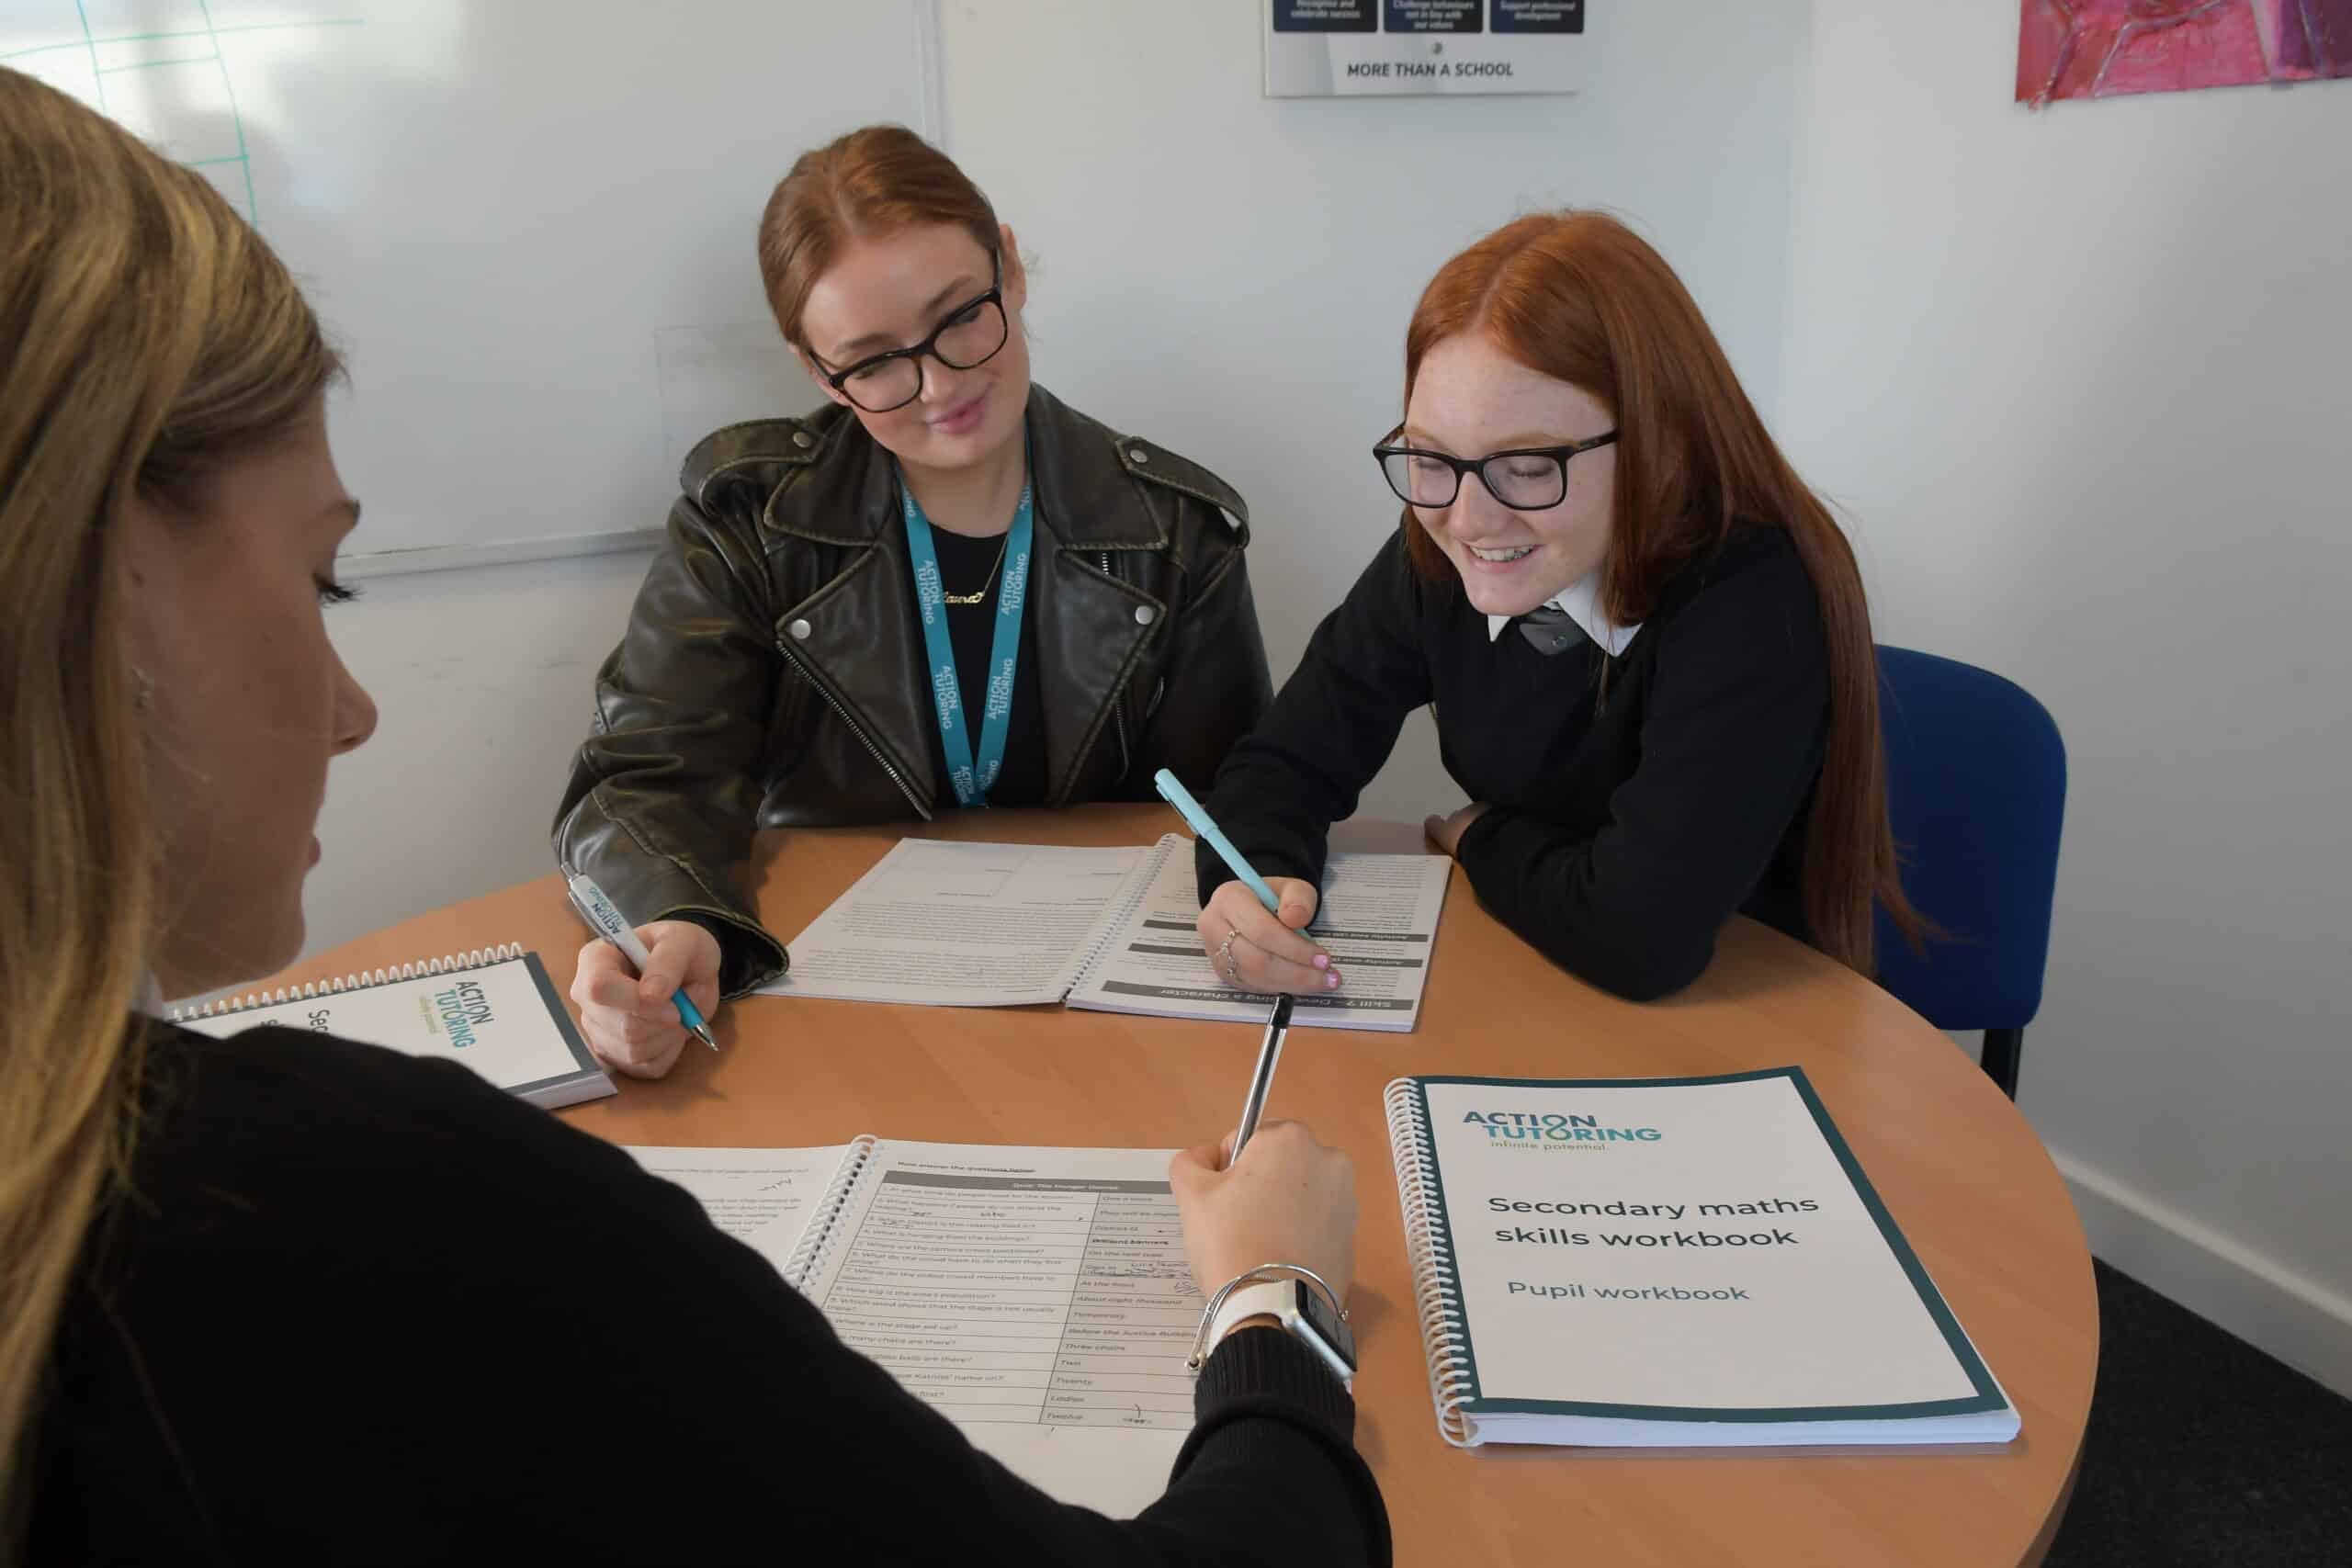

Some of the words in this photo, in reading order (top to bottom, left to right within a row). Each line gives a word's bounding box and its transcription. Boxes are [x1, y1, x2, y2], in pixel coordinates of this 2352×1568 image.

[1347, 62, 1390, 77] MORE
[1395, 62, 1436, 77] THAN
[1440, 63, 1452, 77] A
[1454, 62, 1514, 77] SCHOOL
[918, 568, 934, 626] TUTORING
[924, 559, 941, 605] ACTION
[1001, 570, 1014, 616] ACTION
[1011, 553, 1027, 610] TUTORING
[934, 673, 953, 730] TUTORING
[943, 665, 958, 711] ACTION
[987, 675, 1001, 721] ACTION
[998, 658, 1013, 716] TUTORING
[456, 980, 494, 1026] ACTION
[1159, 988, 1229, 1000] character
[1360, 999, 1392, 1008] Skill
[434, 988, 477, 1049] TUTORING
[1462, 1111, 1597, 1128] ACTION
[1481, 1125, 1662, 1142] TUTORING
[1491, 1139, 1538, 1149] infinite
[1544, 1143, 1606, 1153] potential
[1487, 1198, 1686, 1220] Secondary
[1698, 1198, 1819, 1216] maths
[1494, 1227, 1590, 1246] skills
[1599, 1228, 1799, 1247] workbook
[1507, 1281, 1586, 1301] Pupil
[1593, 1286, 1750, 1301] workbook
